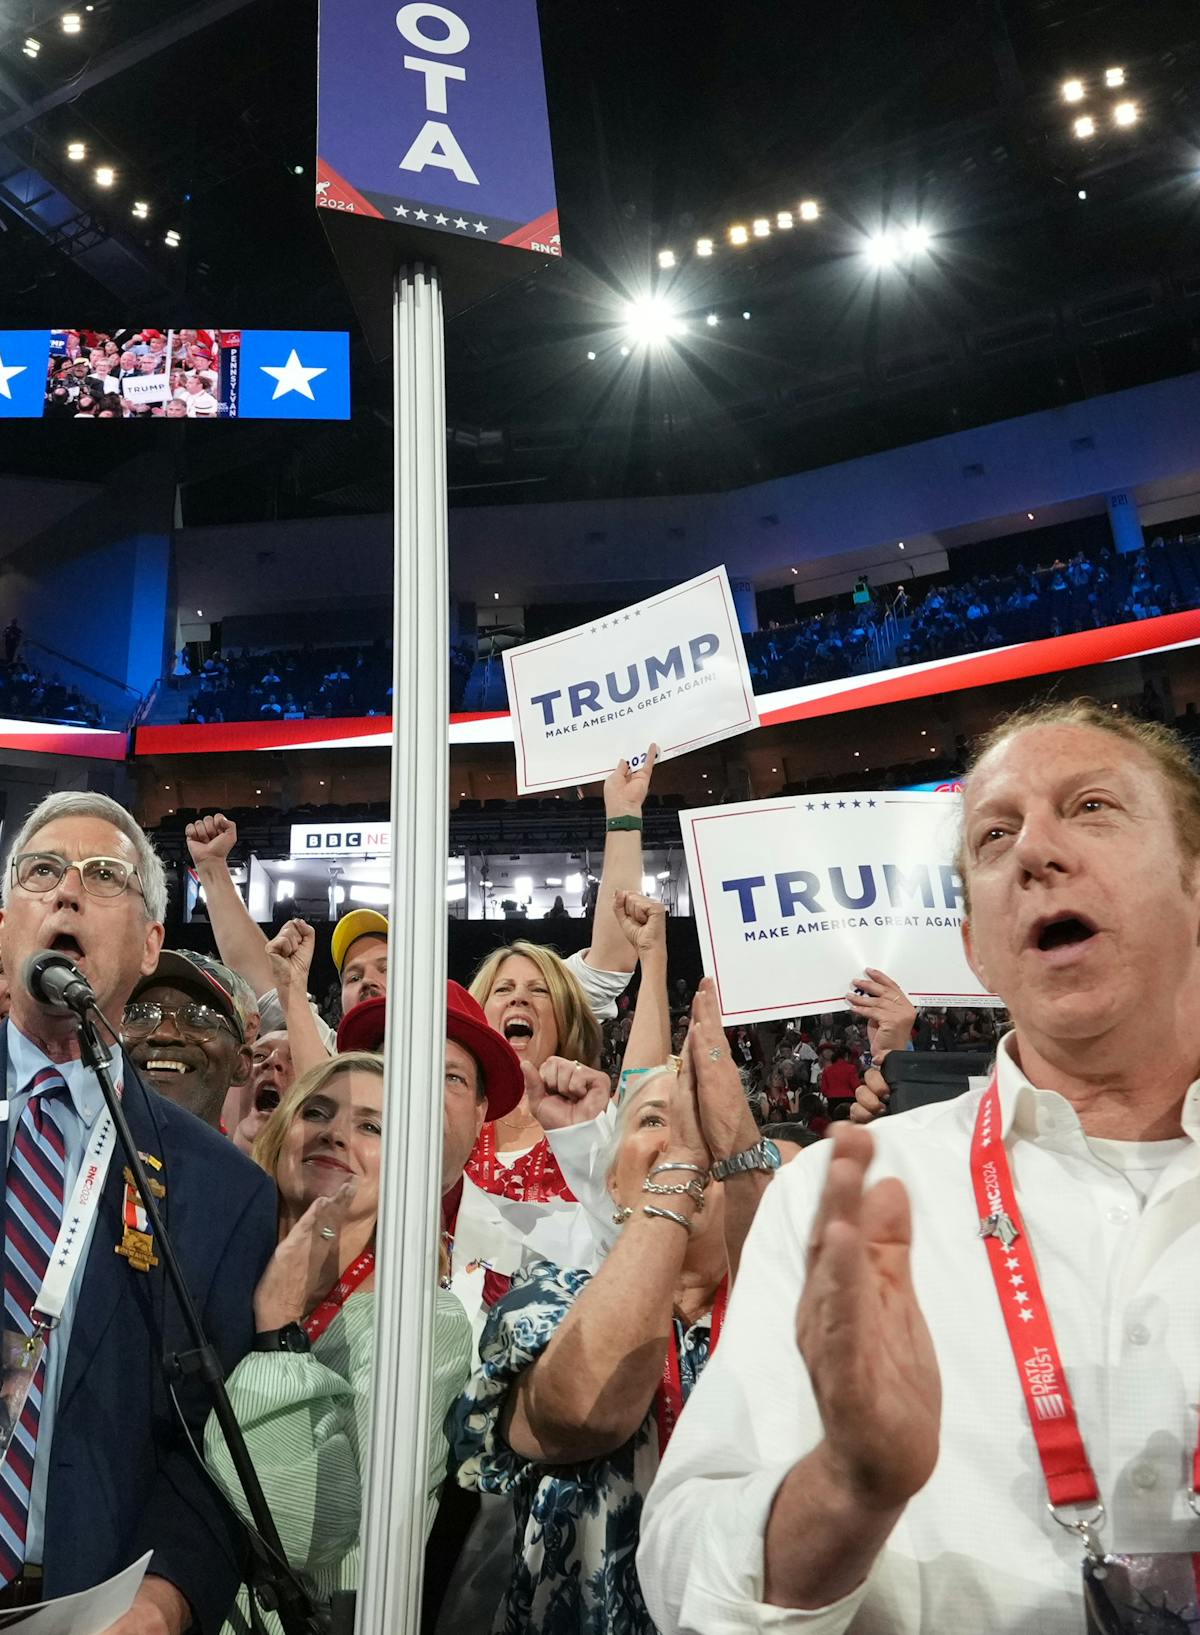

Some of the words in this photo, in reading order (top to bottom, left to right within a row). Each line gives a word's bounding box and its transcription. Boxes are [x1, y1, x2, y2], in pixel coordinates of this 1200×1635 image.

[396, 2, 481, 185] OTA
[319, 197, 355, 212] 2024
[531, 241, 560, 256] RNC
[127, 383, 165, 393] TRUMP
[531, 633, 720, 725] TRUMP
[545, 723, 578, 739] MAKE
[582, 707, 634, 729] AMERICA
[637, 690, 673, 710] GREAT
[677, 672, 717, 695] AGAIN!
[306, 833, 361, 848] BBC
[744, 925, 790, 942] MAKE
[796, 917, 869, 935] AMERICA
[874, 916, 920, 927] GREAT
[80, 1165, 97, 1205] RNC2024
[1024, 1356, 1046, 1396] DATA
[1033, 1346, 1059, 1394] TRUST
